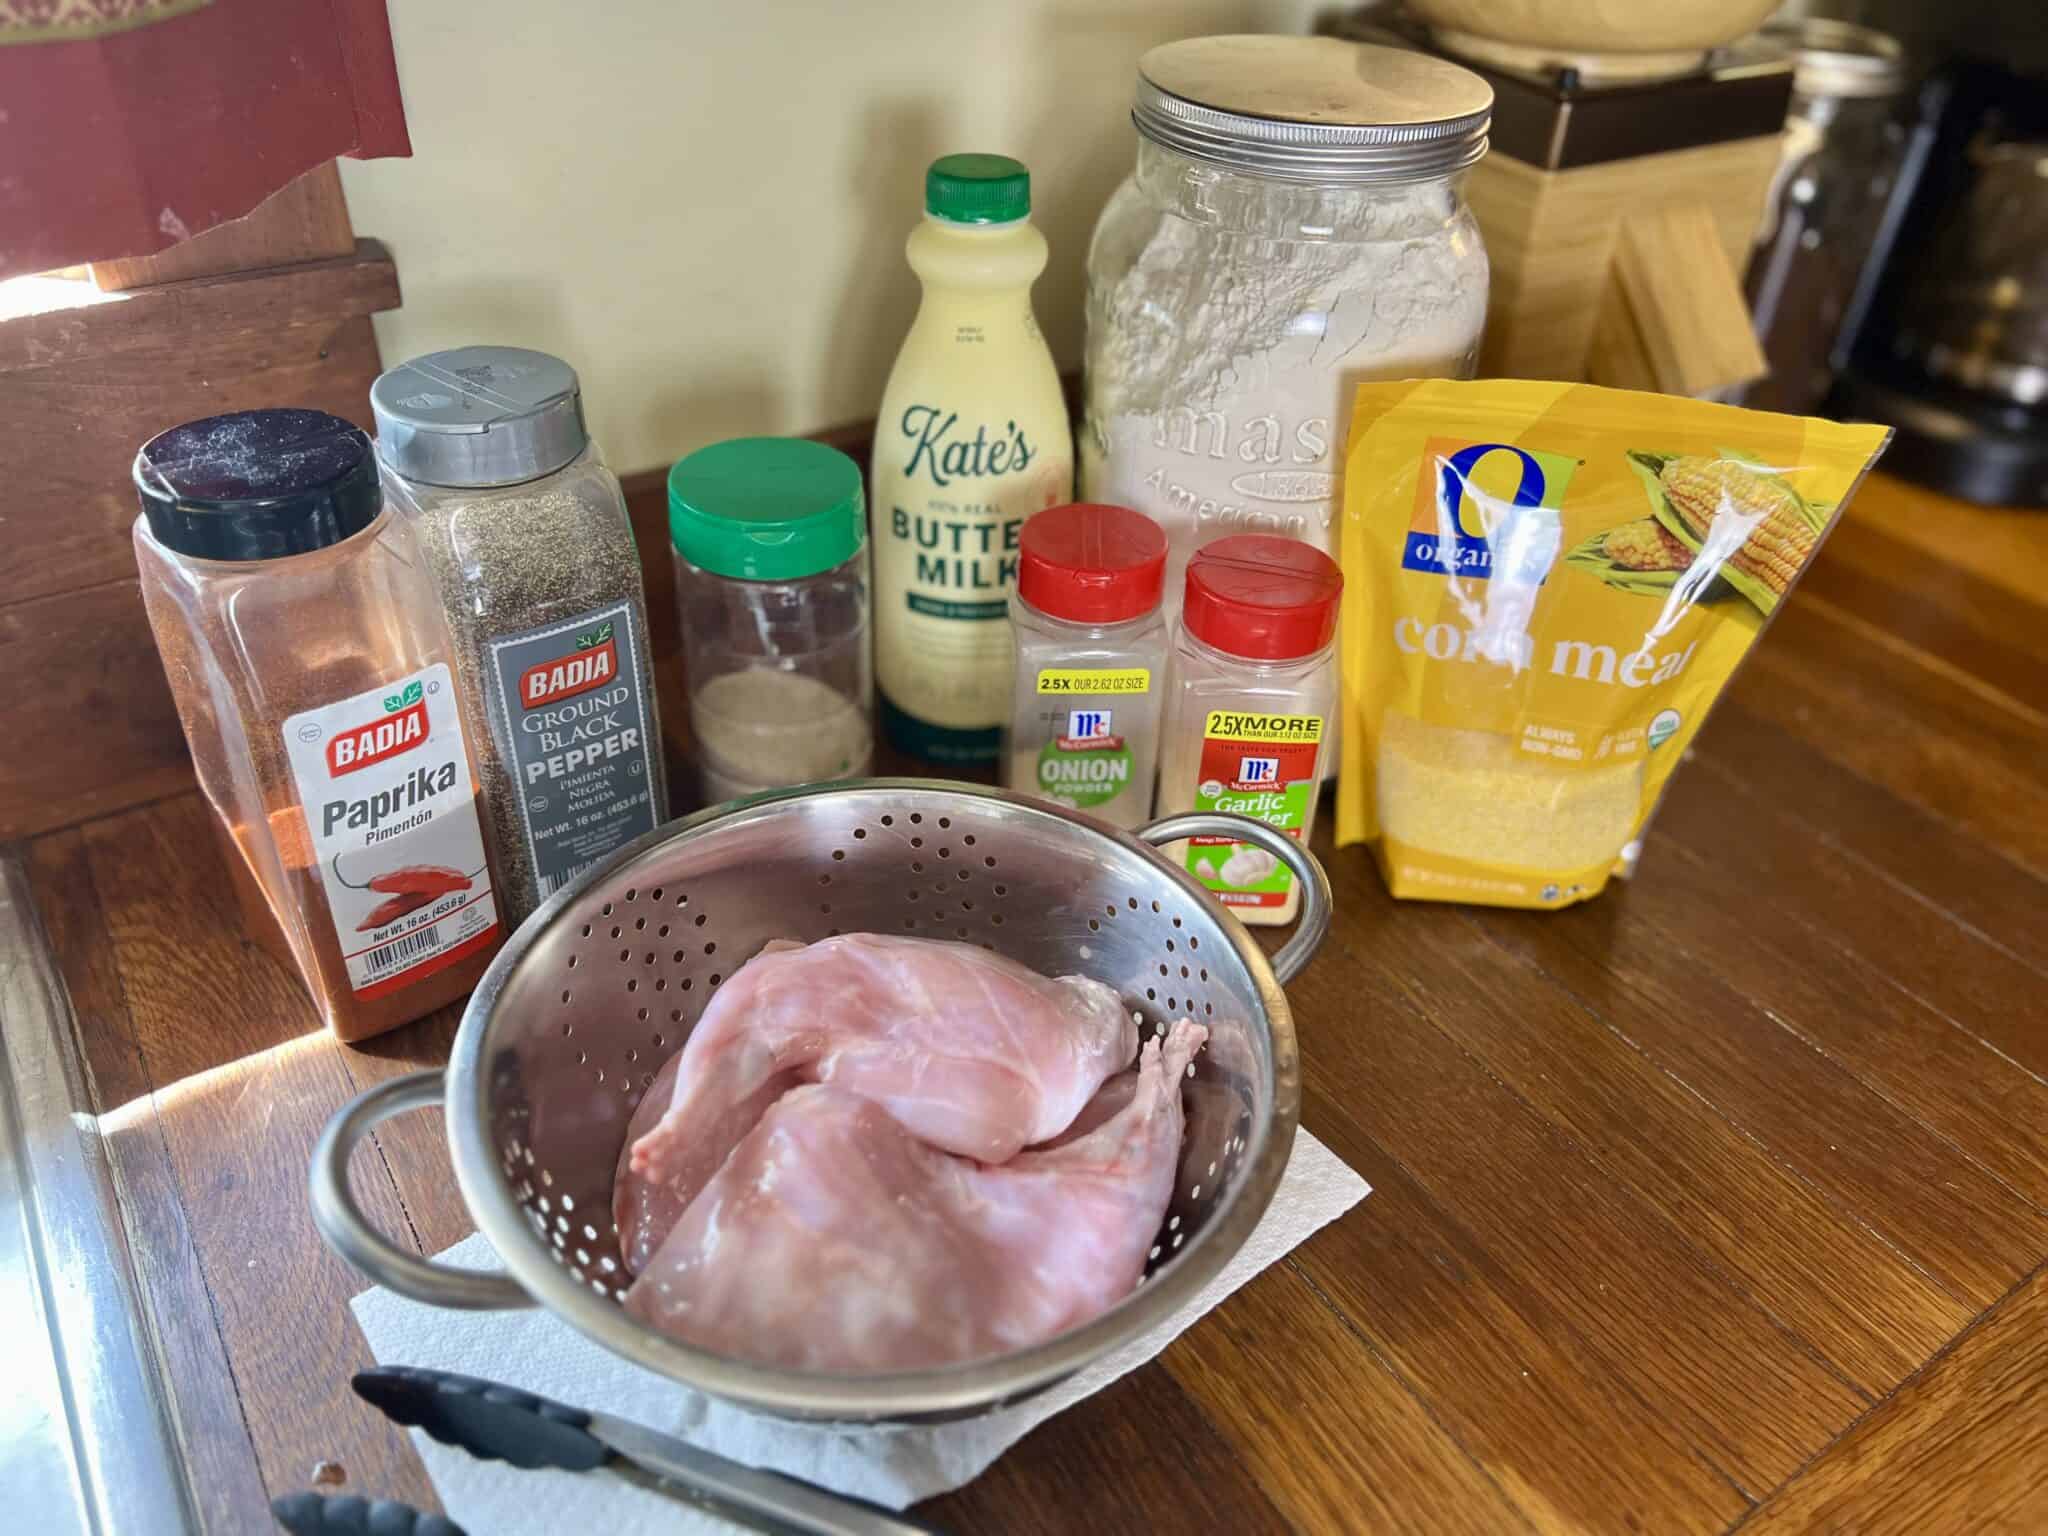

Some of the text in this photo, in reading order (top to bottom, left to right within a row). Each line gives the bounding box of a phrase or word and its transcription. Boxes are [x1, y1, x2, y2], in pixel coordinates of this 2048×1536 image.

[902, 405, 1037, 487] Kate's
[1153, 405, 1331, 464] mas
[892, 506, 1024, 553] BUTTE
[917, 553, 1018, 588] MILK
[528, 650, 610, 700] BADIA
[1551, 639, 1698, 689] meal
[1041, 677, 1145, 690] 2.5X OUR 2.62 OZ SIZE
[521, 686, 630, 735] GROUND
[1210, 714, 1321, 736] 2.5X MORE
[334, 711, 422, 769] BADIA
[540, 711, 624, 754] BLACK
[1243, 730, 1262, 738] THAN
[526, 727, 640, 786] PEPPER
[1040, 757, 1129, 783] ONION
[559, 763, 616, 791] PIMIENTA
[569, 779, 611, 800] NEGRA
[322, 760, 457, 838] Paprika
[1214, 791, 1287, 813] Garlic
[365, 808, 433, 846] Pimentón
[534, 829, 553, 841] Net
[576, 815, 589, 828] 16
[373, 930, 389, 943] Net
[406, 917, 417, 929] 16
[418, 912, 431, 924] oz.
